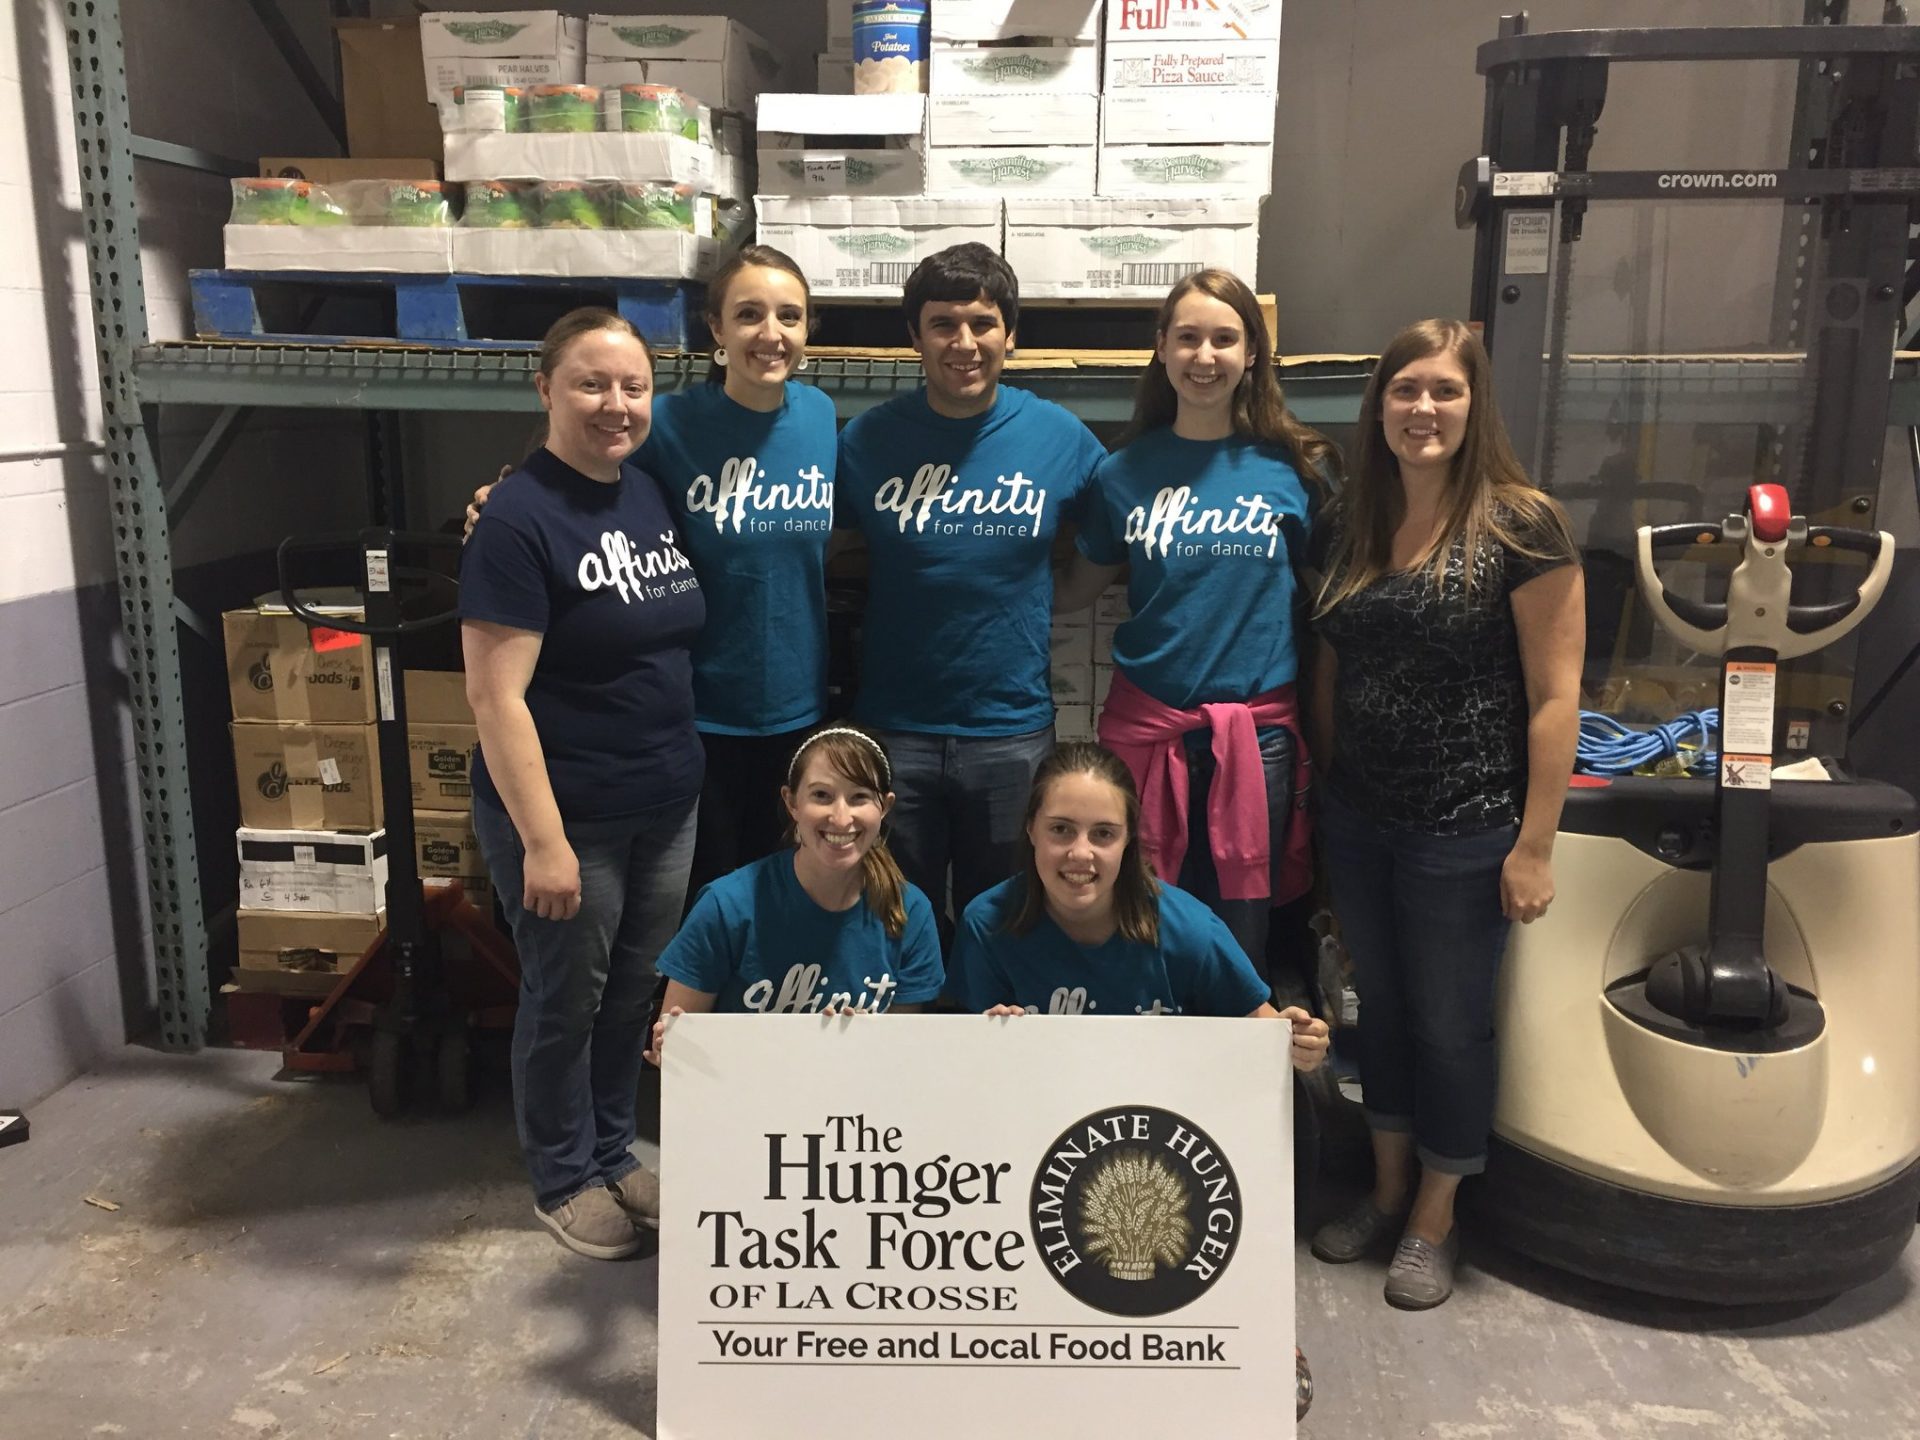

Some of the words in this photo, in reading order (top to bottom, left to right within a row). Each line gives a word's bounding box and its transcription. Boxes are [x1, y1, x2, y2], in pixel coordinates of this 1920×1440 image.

[1119, 0, 1169, 30] Full
[871, 41, 910, 52] Potatoes
[498, 65, 517, 73] PEAR
[520, 65, 550, 73] HALVES
[1153, 53, 1178, 68] Fully
[1180, 53, 1224, 66] Prepared
[994, 65, 1033, 82] Harvest
[1152, 68, 1183, 83] Pizza
[1188, 67, 1224, 82] Sauce
[988, 154, 1034, 169] Bountiful
[1162, 154, 1208, 168] Bountiful
[991, 166, 1032, 183] Harvest
[1165, 164, 1204, 181] Harvest
[1657, 170, 1777, 188] crown.com
[863, 241, 894, 254] Harvest
[1114, 241, 1147, 256] Harvest
[686, 456, 834, 535] affinity
[874, 463, 1046, 538] affinity
[750, 517, 776, 532] for
[784, 517, 827, 532] dance
[934, 519, 963, 535] for
[972, 520, 1027, 537] dance
[1125, 485, 1283, 561] affinity
[1176, 541, 1203, 557] for
[1211, 541, 1263, 558] dance
[645, 585, 666, 600] for
[433, 755, 461, 763] Golden
[438, 762, 456, 770] Grill
[825, 1113, 903, 1153] The
[763, 1133, 1012, 1219] Hunger
[1037, 1114, 1150, 1278] ELIMINATE
[1164, 1124, 1234, 1281] HUNGER
[697, 1207, 841, 1269] Task
[866, 1211, 1025, 1272] Force
[709, 1284, 766, 1309] OF
[776, 1281, 835, 1309] LA
[846, 1281, 1018, 1311] CROSSE
[712, 1329, 788, 1357] Your
[797, 1330, 868, 1358] Free
[877, 1331, 939, 1358] and
[950, 1331, 1041, 1359] Local
[1050, 1332, 1132, 1360] Food
[1142, 1333, 1226, 1361] Bank
